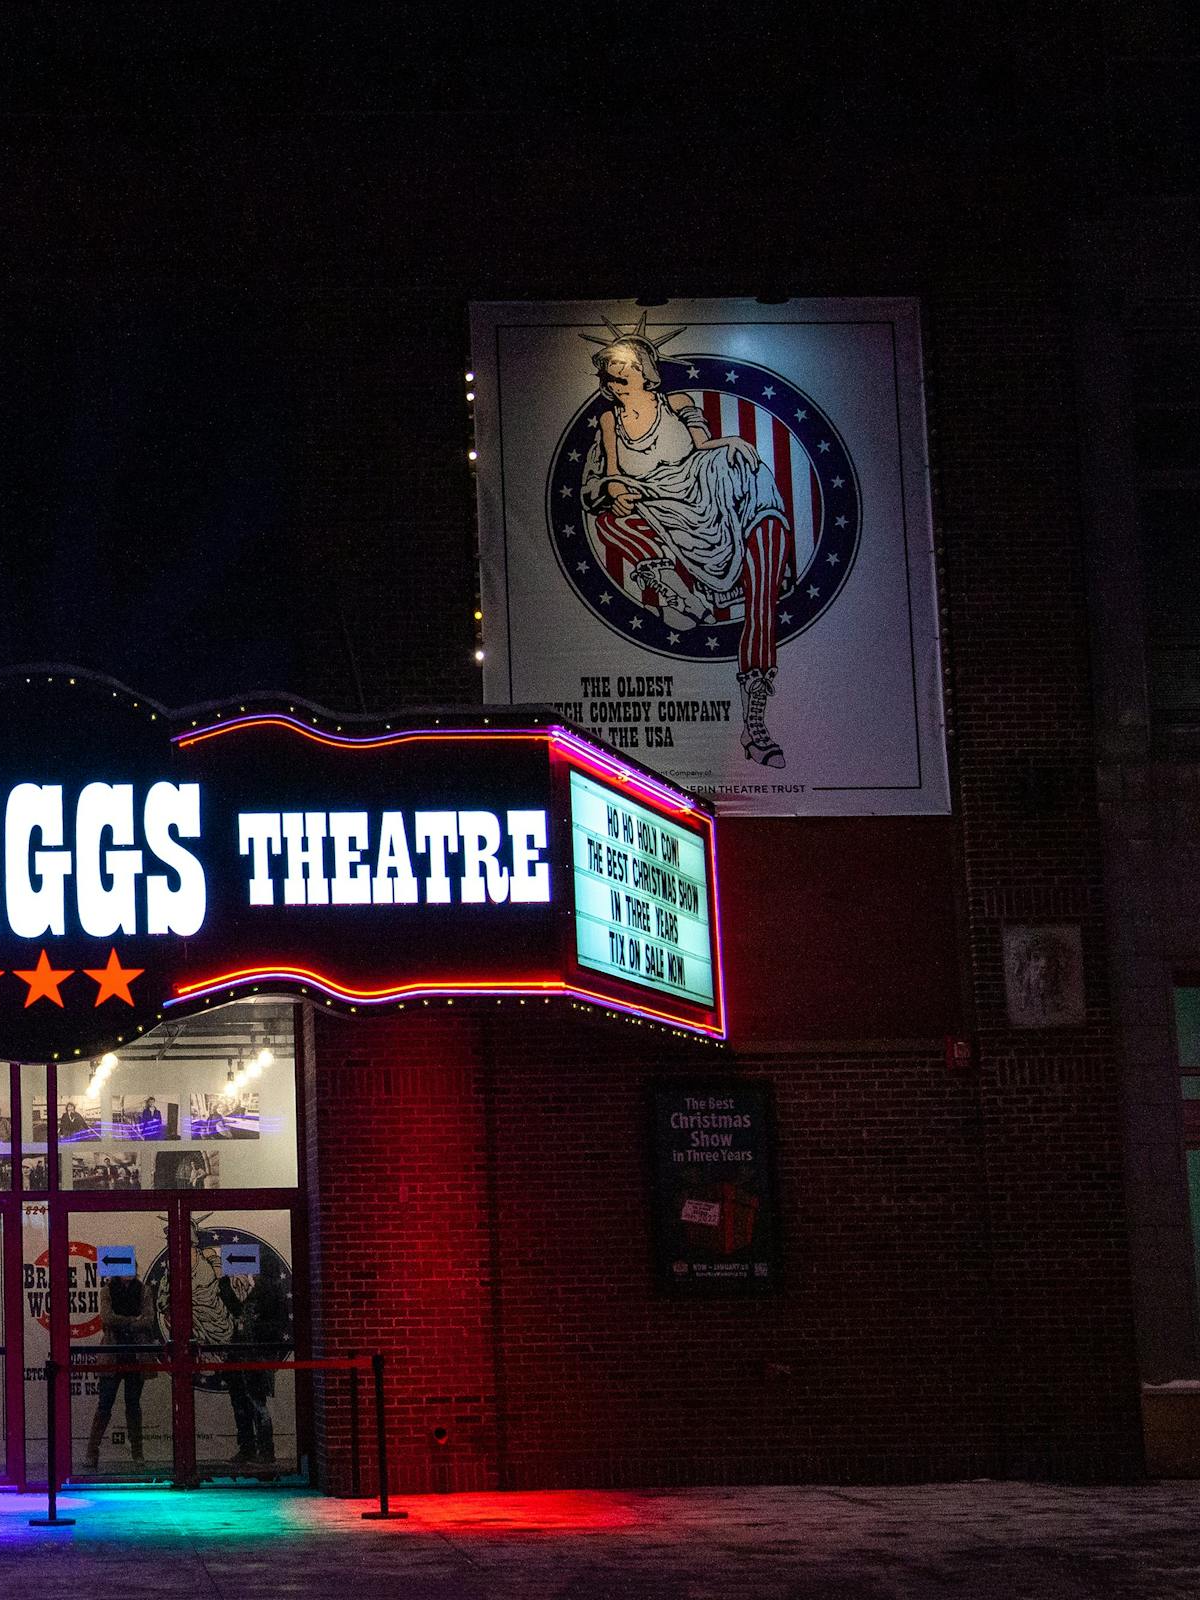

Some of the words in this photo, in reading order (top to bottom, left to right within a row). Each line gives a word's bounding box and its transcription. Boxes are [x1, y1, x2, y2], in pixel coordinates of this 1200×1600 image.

[581, 677, 611, 697] THE
[617, 676, 673, 697] OLDEST
[590, 702, 651, 722] COMEDY
[658, 701, 731, 722] COMPANY
[609, 727, 639, 747] THE
[645, 727, 674, 747] USA
[669, 770, 703, 778] Company
[718, 785, 768, 794] THEATRE
[771, 785, 805, 793] TRUST
[607, 805, 619, 839] HO
[622, 812, 634, 844] HO
[636, 819, 657, 856] HOLY
[661, 832, 680, 868] COW!
[238, 810, 550, 906] THEATRE
[587, 838, 603, 874] THE
[606, 846, 628, 883] BEST
[632, 858, 677, 905] CHRISTMAS
[678, 878, 699, 915] SHOW
[610, 889, 621, 922] IN
[625, 895, 651, 933] THREE
[655, 906, 678, 944] YEARS
[609, 931, 625, 966] TIX
[629, 938, 641, 971] ON
[645, 944, 664, 978] SALE
[667, 951, 686, 986] NOW!
[684, 1097, 706, 1110] The
[708, 1097, 735, 1110] Best
[670, 1112, 752, 1129] Christmas
[690, 1130, 733, 1147] Show
[672, 1149, 684, 1162] in
[686, 1149, 719, 1162] Three
[720, 1149, 753, 1162] Years
